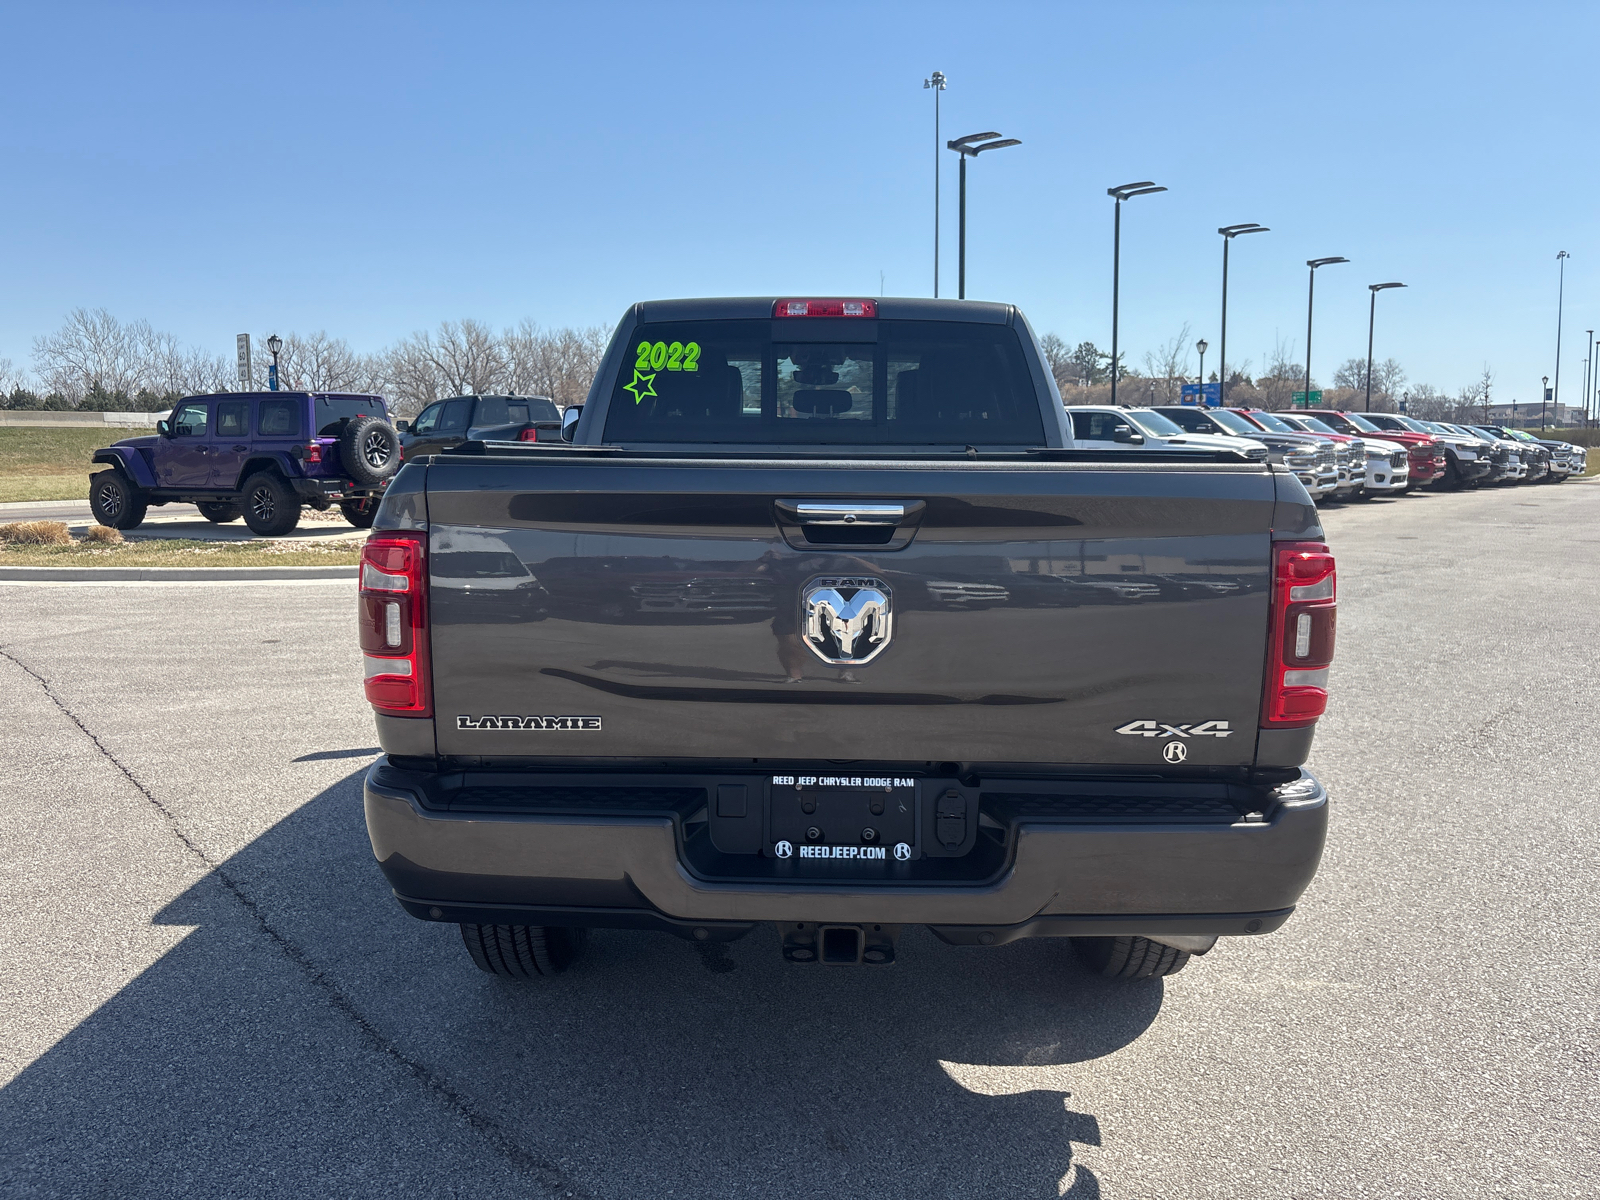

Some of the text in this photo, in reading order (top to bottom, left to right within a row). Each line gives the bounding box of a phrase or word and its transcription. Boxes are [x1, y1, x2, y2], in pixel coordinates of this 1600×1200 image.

[635, 341, 702, 372] 2022
[821, 579, 877, 587] RAM
[456, 715, 602, 731] LARAMIE
[1114, 719, 1235, 738] 4x4
[772, 775, 915, 787] REED JEEP CHRYSLER DODGE RAM
[799, 845, 886, 860] REEDJEEP.COM
